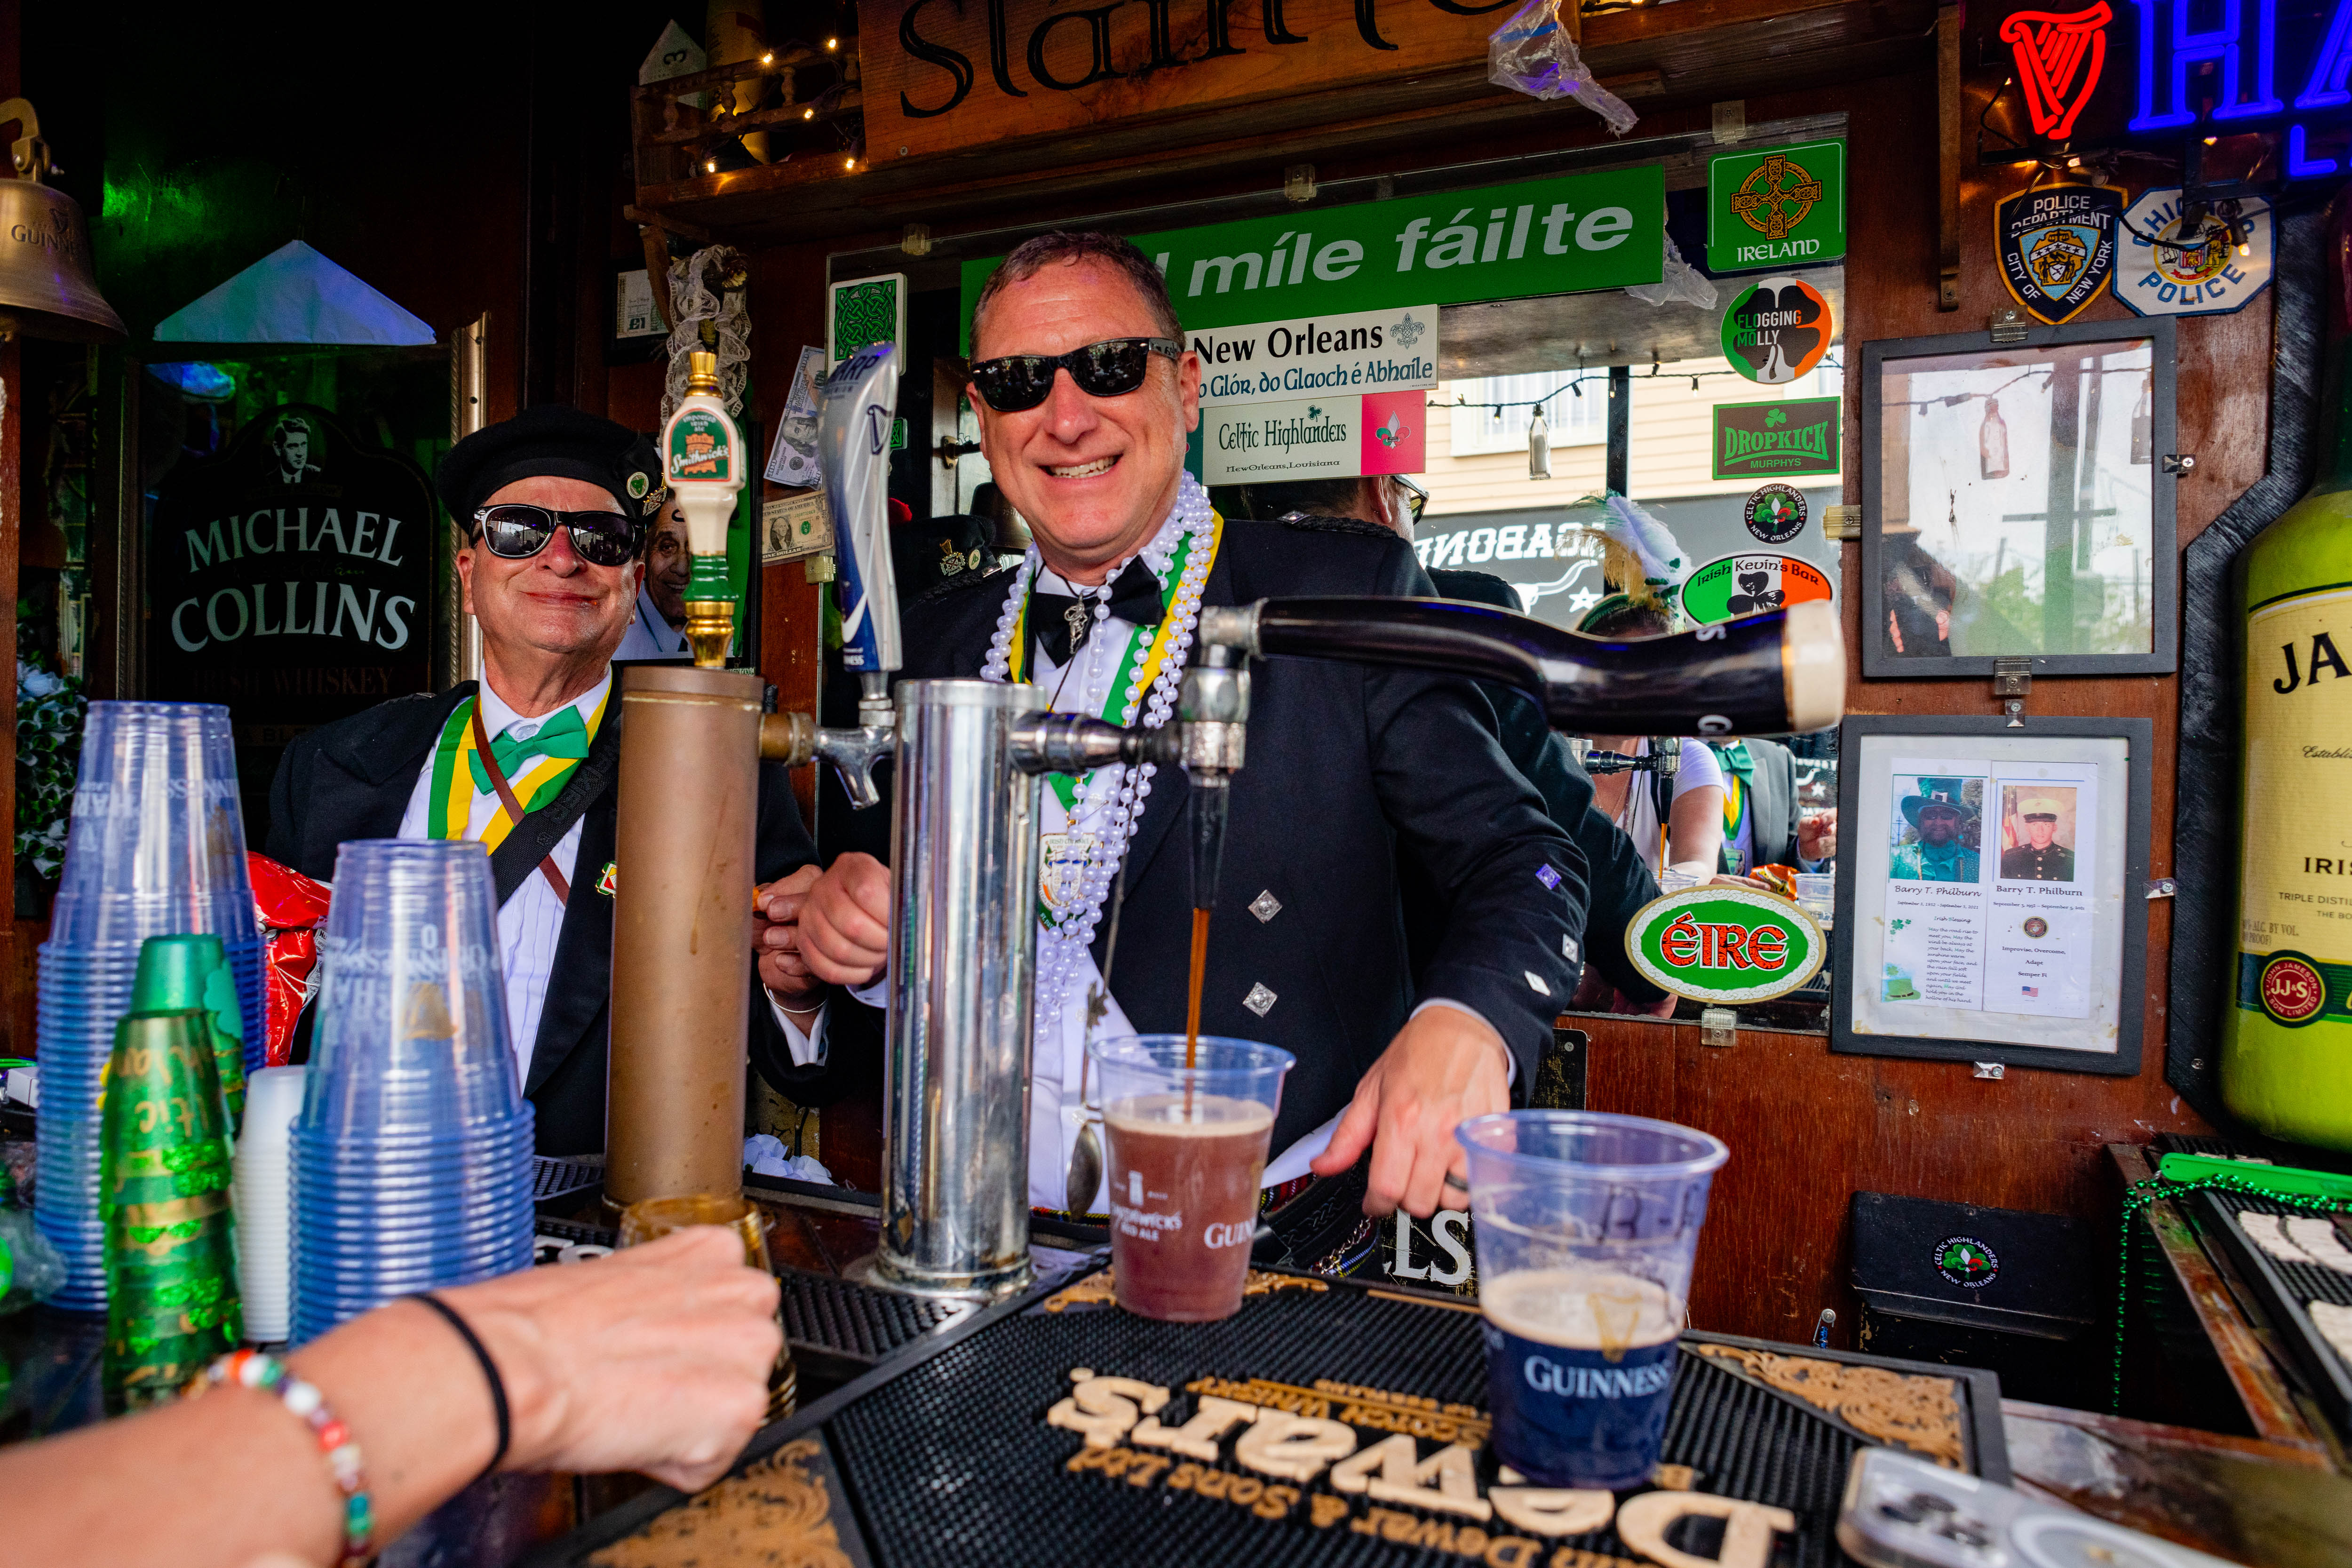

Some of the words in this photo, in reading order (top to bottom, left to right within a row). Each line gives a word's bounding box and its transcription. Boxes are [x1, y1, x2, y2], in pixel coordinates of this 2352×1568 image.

[2034, 195, 2090, 214] POLICE
[2011, 210, 2111, 239] DEPARTMENT
[1188, 231, 1364, 297] míle
[1396, 203, 1633, 272] fáilte
[1738, 239, 1820, 262] IRELAND
[2007, 252, 2027, 280] CITY
[2023, 284, 2041, 298] OF
[2066, 277, 2093, 304] NEW
[2088, 240, 2113, 274] YORK
[2137, 263, 2246, 305] POLICE
[1738, 310, 1802, 330] FLOGGING
[1194, 336, 1255, 364] New
[1268, 323, 1383, 358] Orleans
[1738, 329, 1780, 347] MOLLY
[1284, 364, 1348, 390] Glaoch
[1352, 362, 1361, 384] é
[1219, 422, 1259, 453] Celtic
[1264, 415, 1346, 454] Highlanders
[1724, 420, 1829, 460] DROPKICK
[1750, 458, 1802, 469] MURPHYS
[1746, 492, 1760, 519] CELTIC
[1759, 484, 1806, 517] HIGHLANDERS
[184, 507, 405, 573] MICHAEL
[1750, 525, 1769, 540] NEW
[1770, 521, 1803, 541] ORLEANS
[1697, 565, 1732, 587] Irish
[170, 581, 417, 653] COLLINS
[1894, 885, 1922, 895] Barry
[1936, 887, 1982, 897] Philburn
[1996, 885, 2023, 895] Barry
[2039, 887, 2083, 896] Philburn
[2279, 892, 2313, 903] TRIPLE
[1660, 911, 1789, 971] ÉIRE
[2265, 965, 2281, 984] JOHN
[2283, 963, 2318, 989] JAMESON
[2271, 978, 2308, 998] JJ&S
[2269, 998, 2284, 1013] SON
[2287, 996, 2318, 1015] LIMITED
[1934, 1242, 1948, 1266] CELTIC
[1947, 1236, 1999, 1269] HIGHLANDERS
[1940, 1270, 1961, 1285] NEW
[1963, 1273, 1996, 1288] ORLEANS
[1524, 1354, 1670, 1400] GUINNESS
[1048, 1376, 1795, 1568] Dewar's
[1168, 1462, 1300, 1520] Sons
